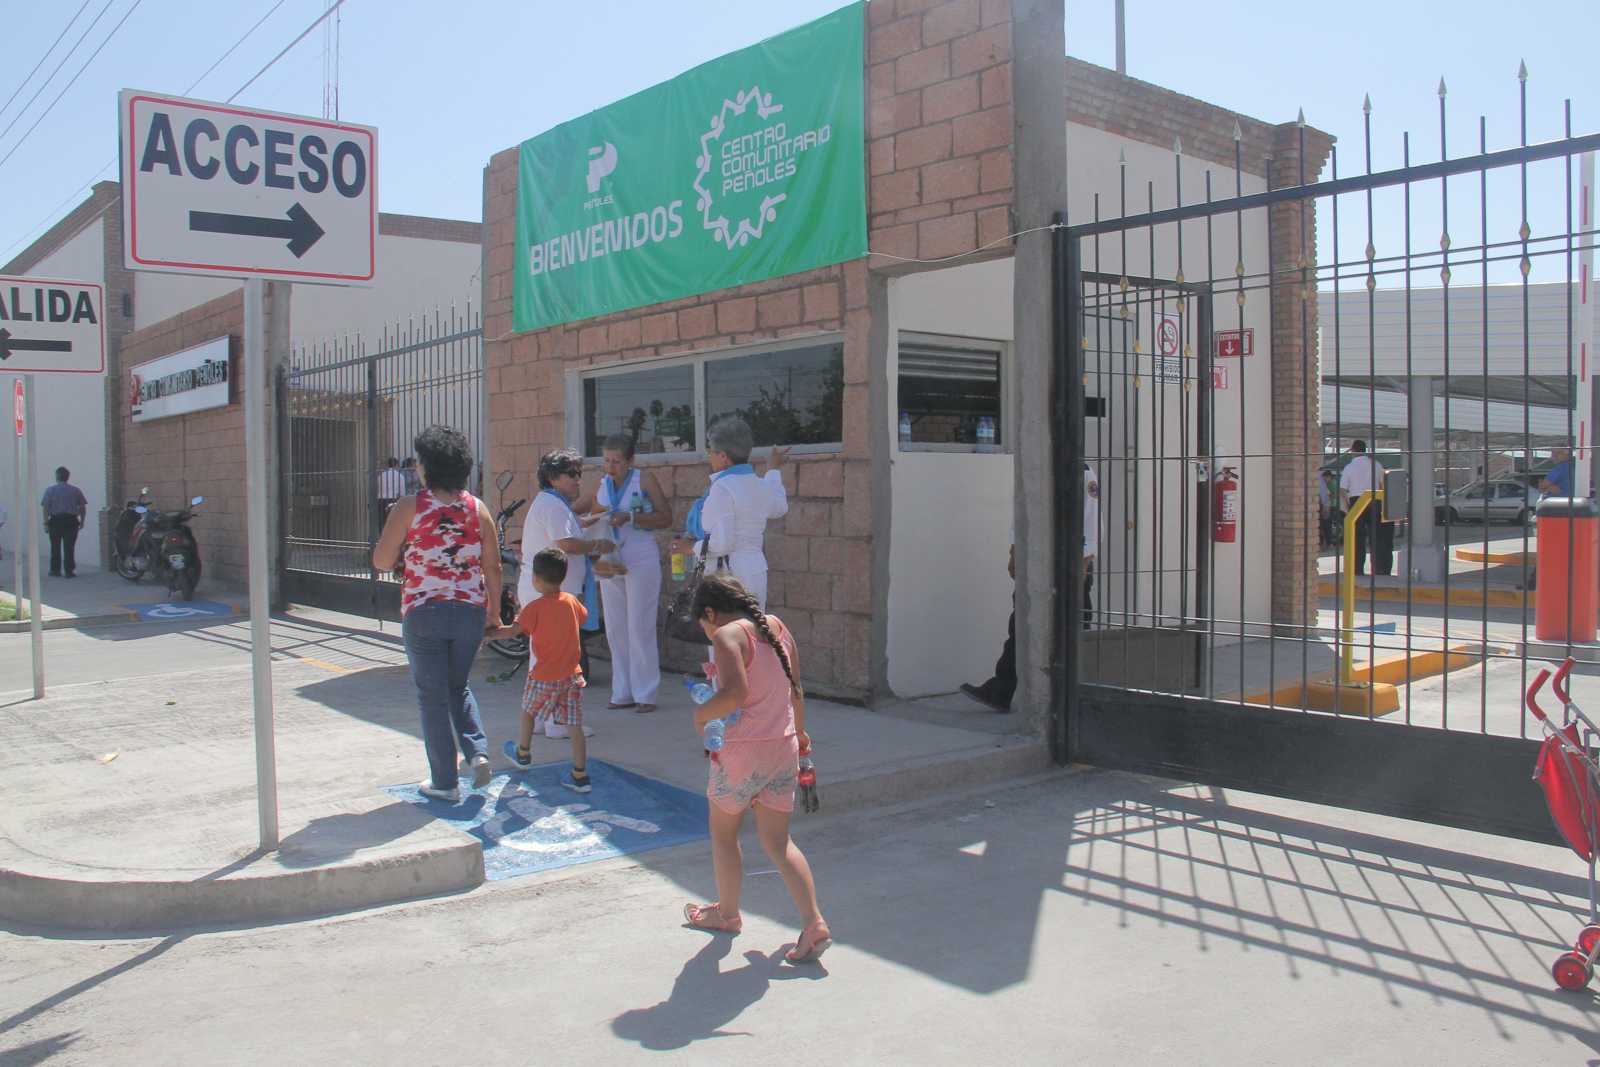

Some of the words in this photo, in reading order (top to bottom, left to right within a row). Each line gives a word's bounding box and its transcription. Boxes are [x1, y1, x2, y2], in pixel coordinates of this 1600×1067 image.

[140, 112, 366, 198] ACCESO
[721, 122, 786, 159] CENTRO
[721, 124, 831, 177] COMUNITARIO
[722, 157, 797, 197] PEÑOLES
[529, 199, 684, 276] BIENVENIDOS
